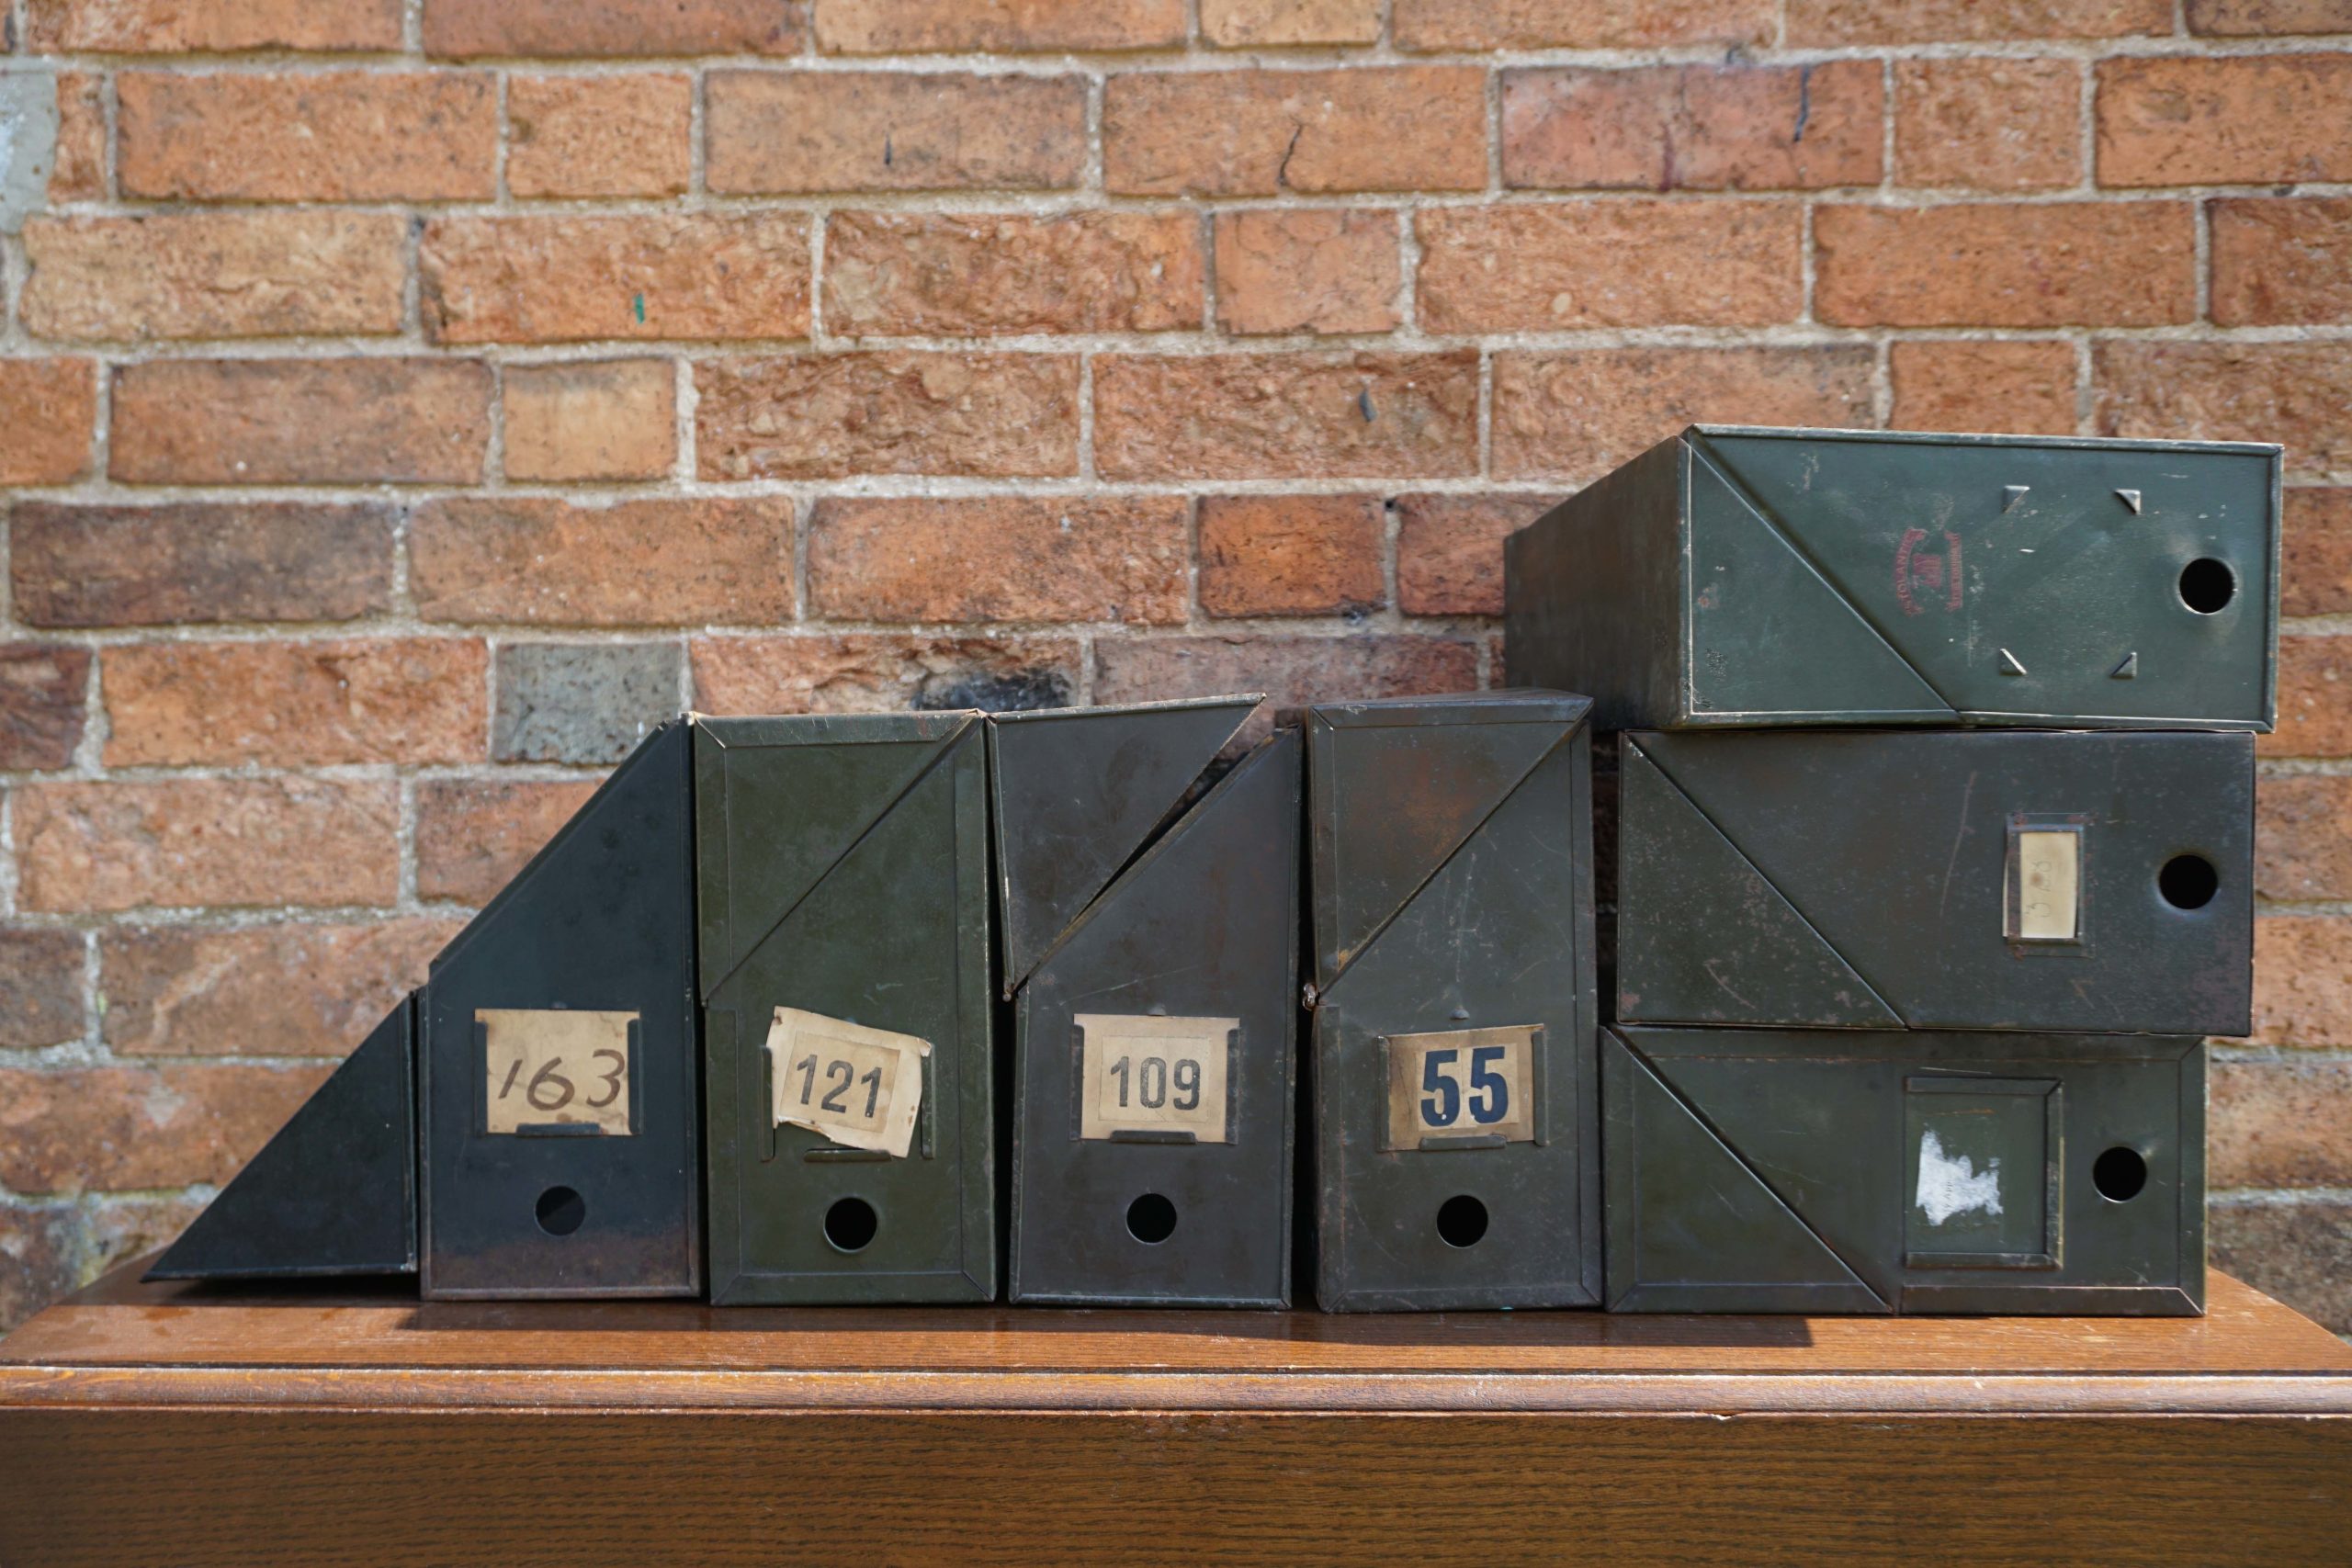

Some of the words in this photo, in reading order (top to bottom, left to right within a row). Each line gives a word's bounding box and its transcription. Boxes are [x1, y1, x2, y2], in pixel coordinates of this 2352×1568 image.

[498, 1049, 625, 1111] 163
[796, 1053, 883, 1118] 121
[1110, 1055, 1201, 1111] 109
[1420, 1045, 1509, 1127] 55
